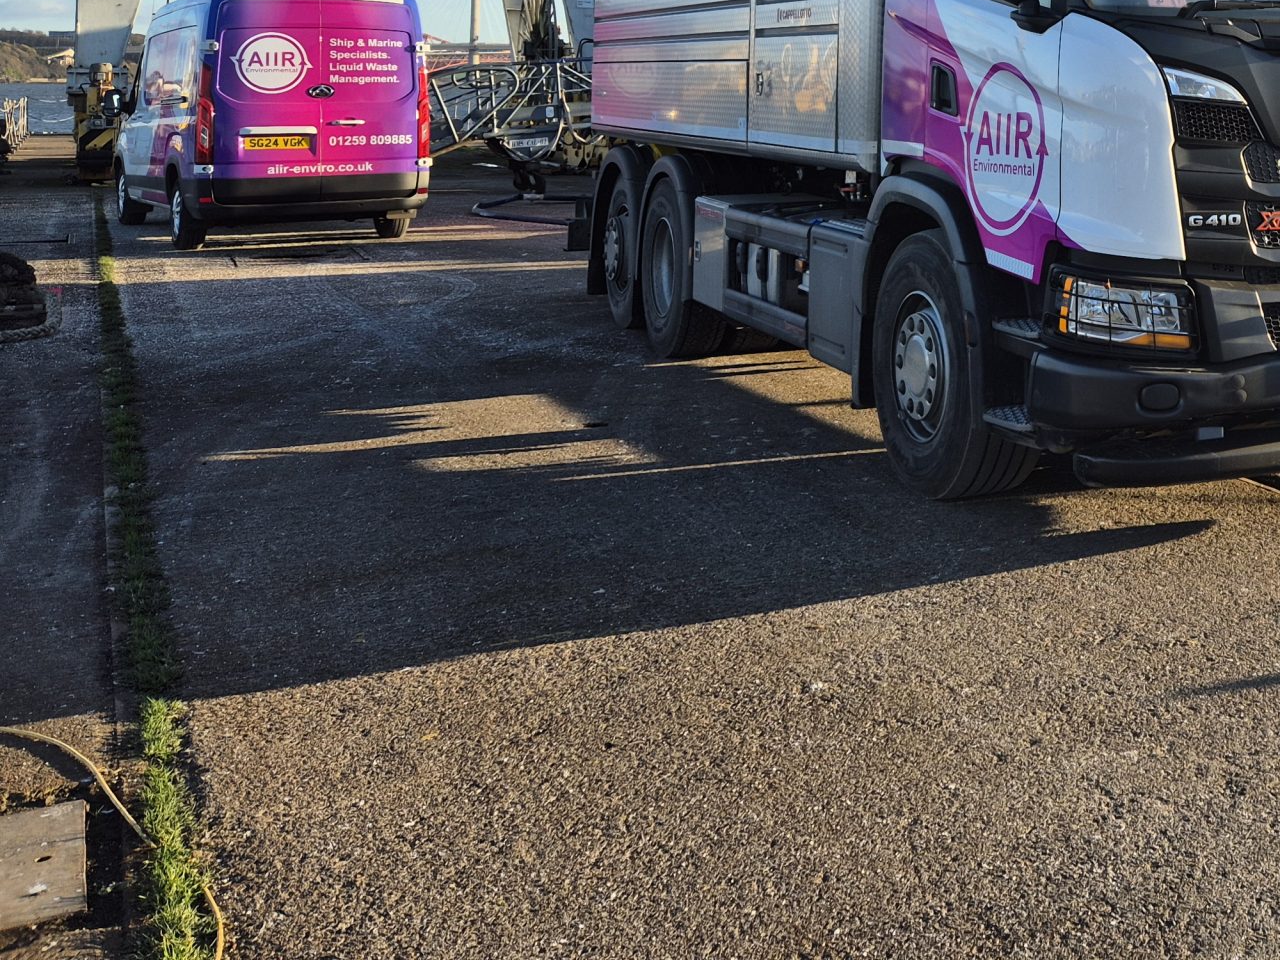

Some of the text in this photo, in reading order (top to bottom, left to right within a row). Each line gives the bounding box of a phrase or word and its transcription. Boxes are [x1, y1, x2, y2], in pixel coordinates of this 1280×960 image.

[329, 38, 403, 48] Ship & Marine
[248, 51, 296, 67] AIIR
[329, 50, 391, 60] Specialists.
[329, 62, 398, 72] Liquid Waste
[329, 74, 400, 84] Management.
[329, 134, 413, 146] 01259 809885
[976, 110, 1033, 159] AIIR
[249, 137, 305, 148] SG24 VGK
[267, 162, 374, 175] aiir-enviro.co.uk
[973, 158, 1035, 177] Environmental
[1188, 214, 1242, 227] G 410
